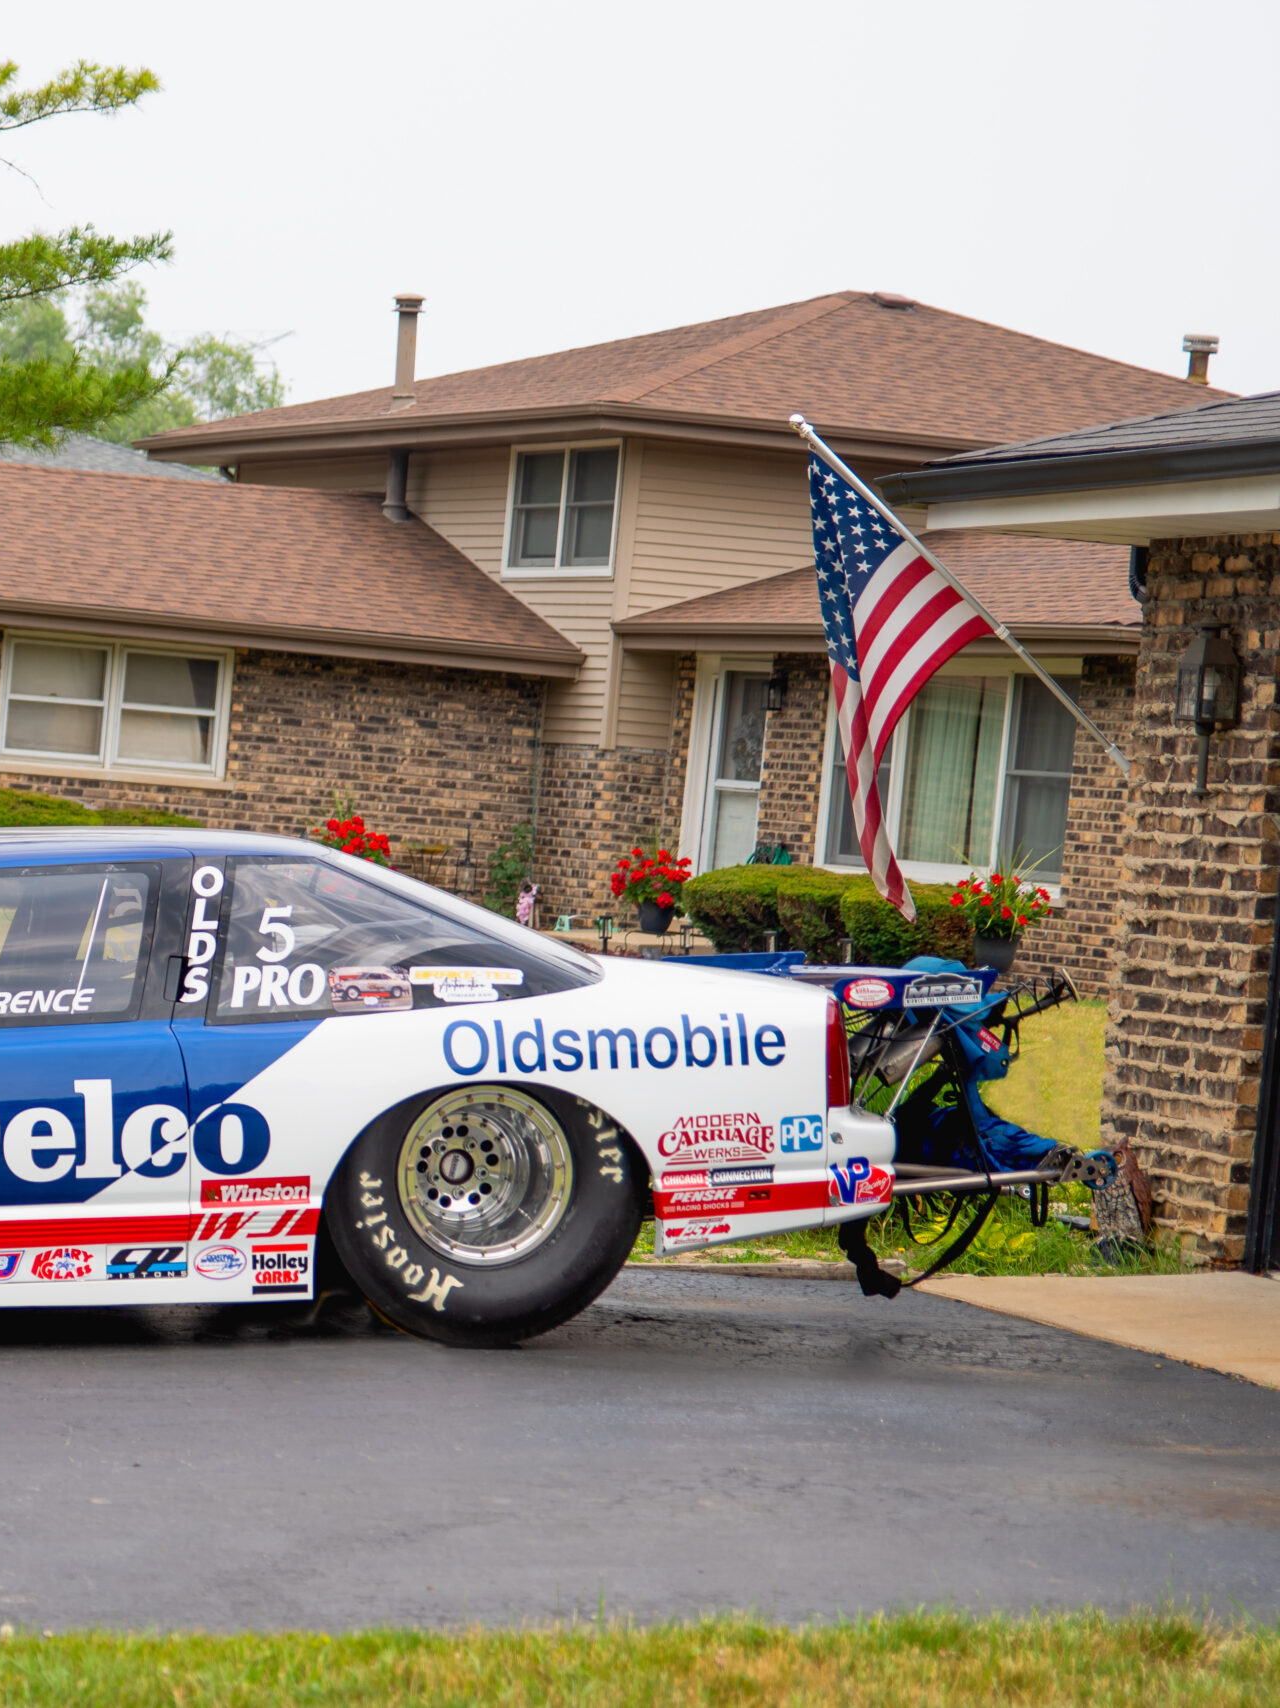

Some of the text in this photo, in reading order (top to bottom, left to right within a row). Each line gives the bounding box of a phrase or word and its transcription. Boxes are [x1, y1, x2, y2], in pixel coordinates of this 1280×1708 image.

[179, 866, 224, 1003] OLDS
[256, 905, 295, 962] 5
[231, 963, 325, 1008] PRO
[908, 984, 978, 998] MPSA
[442, 1013, 787, 1076] Oldsmobile
[673, 1112, 762, 1130] MODERN
[657, 1125, 775, 1158] CARRIAGE
[694, 1146, 741, 1160] WERKS
[663, 1169, 771, 1186] CHICAGO CONNECTION
[829, 1156, 871, 1205] VP
[220, 1184, 308, 1202] Winston
[671, 1188, 738, 1204] PENSKE
[676, 1201, 730, 1211] RACING SHOCKS
[356, 1171, 464, 1311] Hoosier
[252, 1253, 308, 1274] Holley
[106, 1270, 188, 1279] PISTONS
[255, 1270, 299, 1285] CARBS
